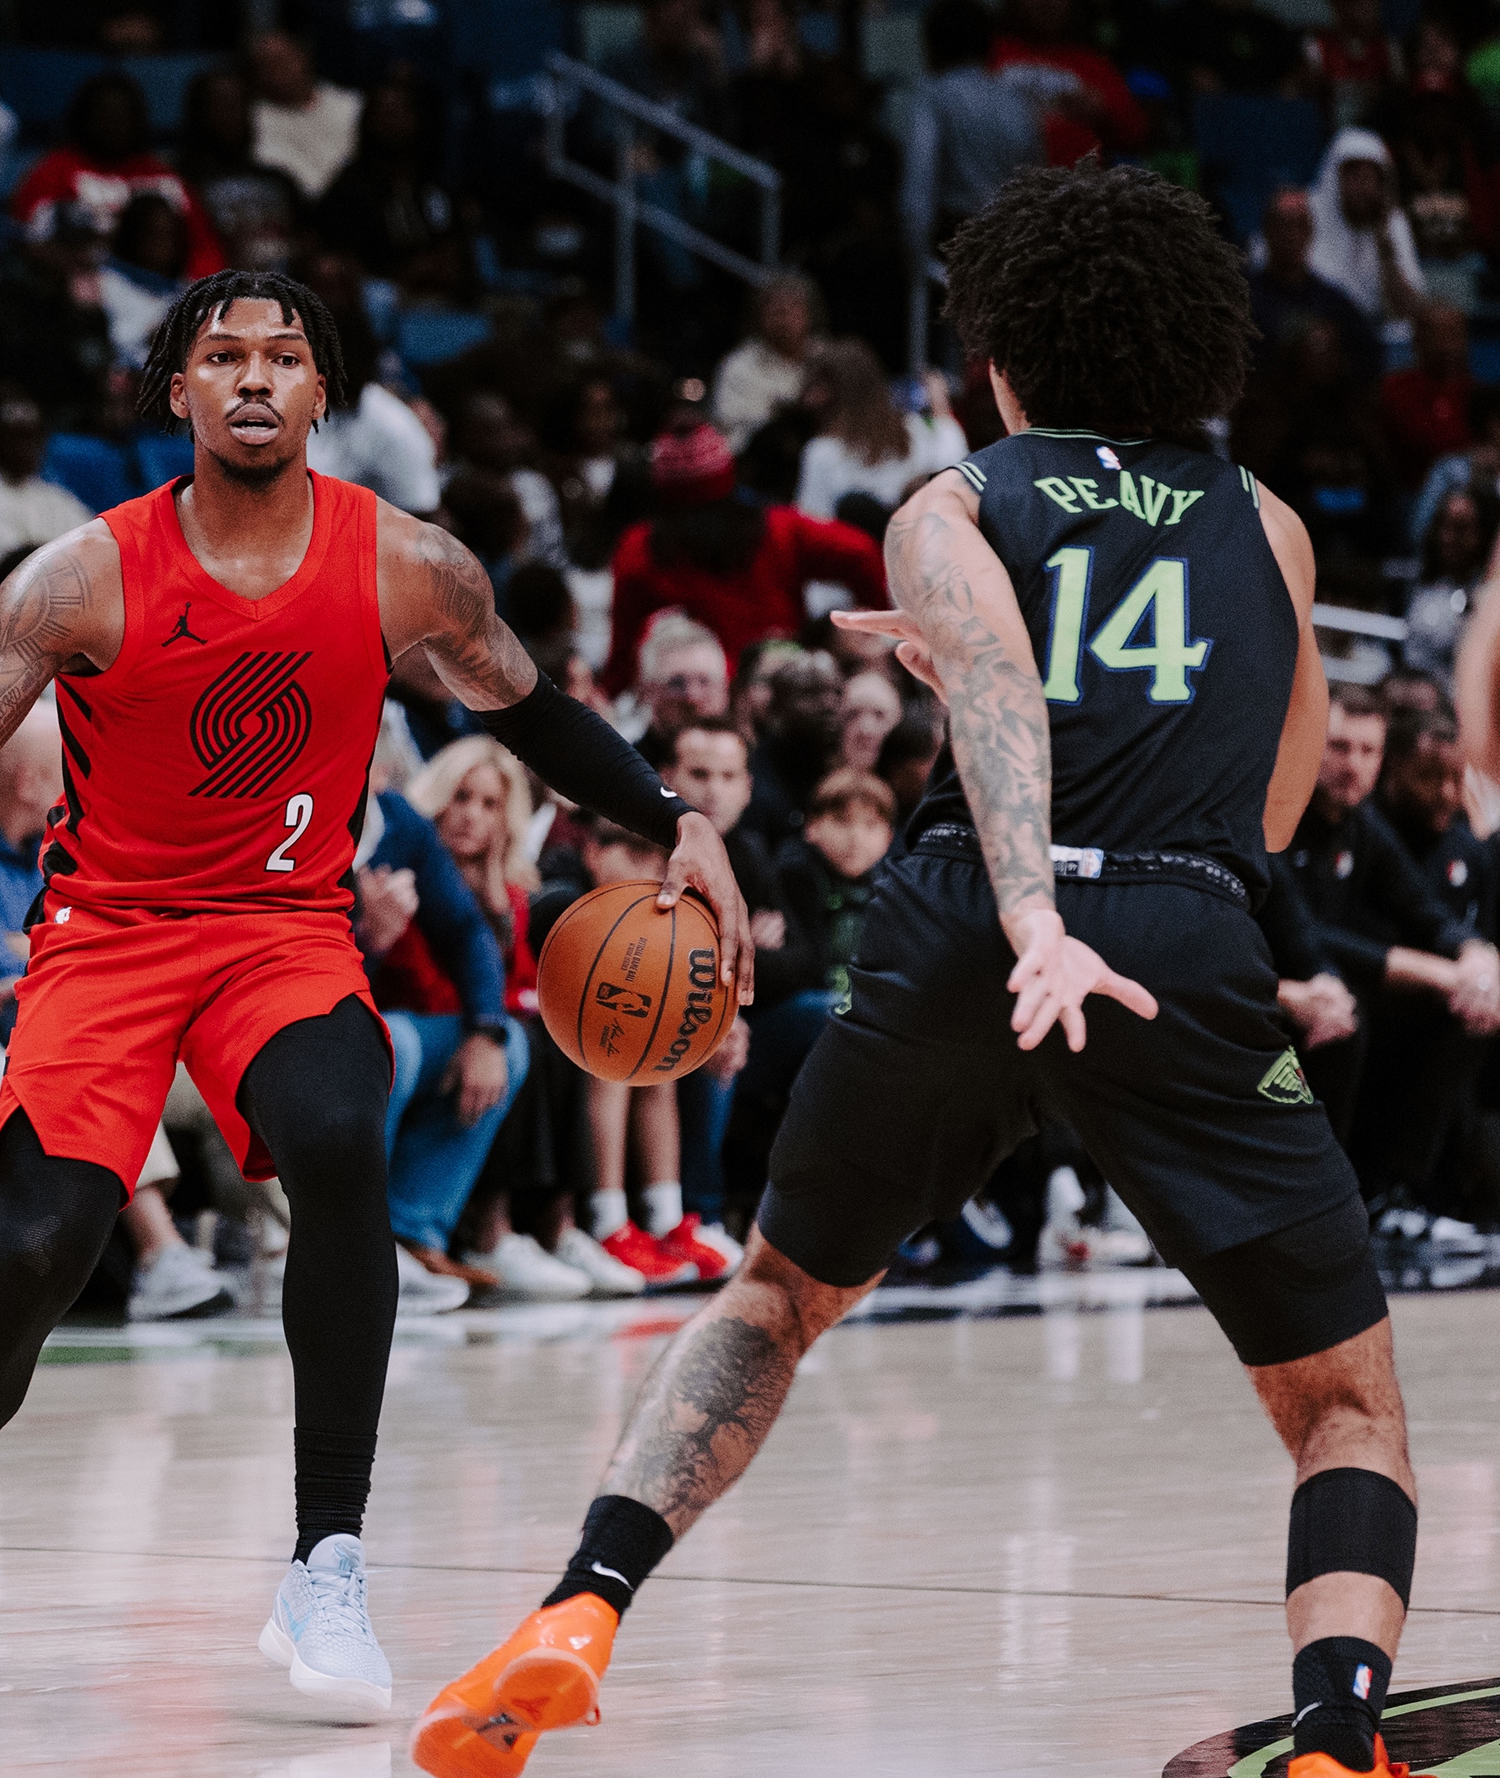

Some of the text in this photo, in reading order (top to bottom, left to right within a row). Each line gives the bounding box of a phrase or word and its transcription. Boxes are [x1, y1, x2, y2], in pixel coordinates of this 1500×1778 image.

[1034, 470, 1204, 526] PEAVY
[1042, 545, 1213, 704] 14
[265, 793, 314, 872] 2
[653, 947, 717, 1072] Wilson
